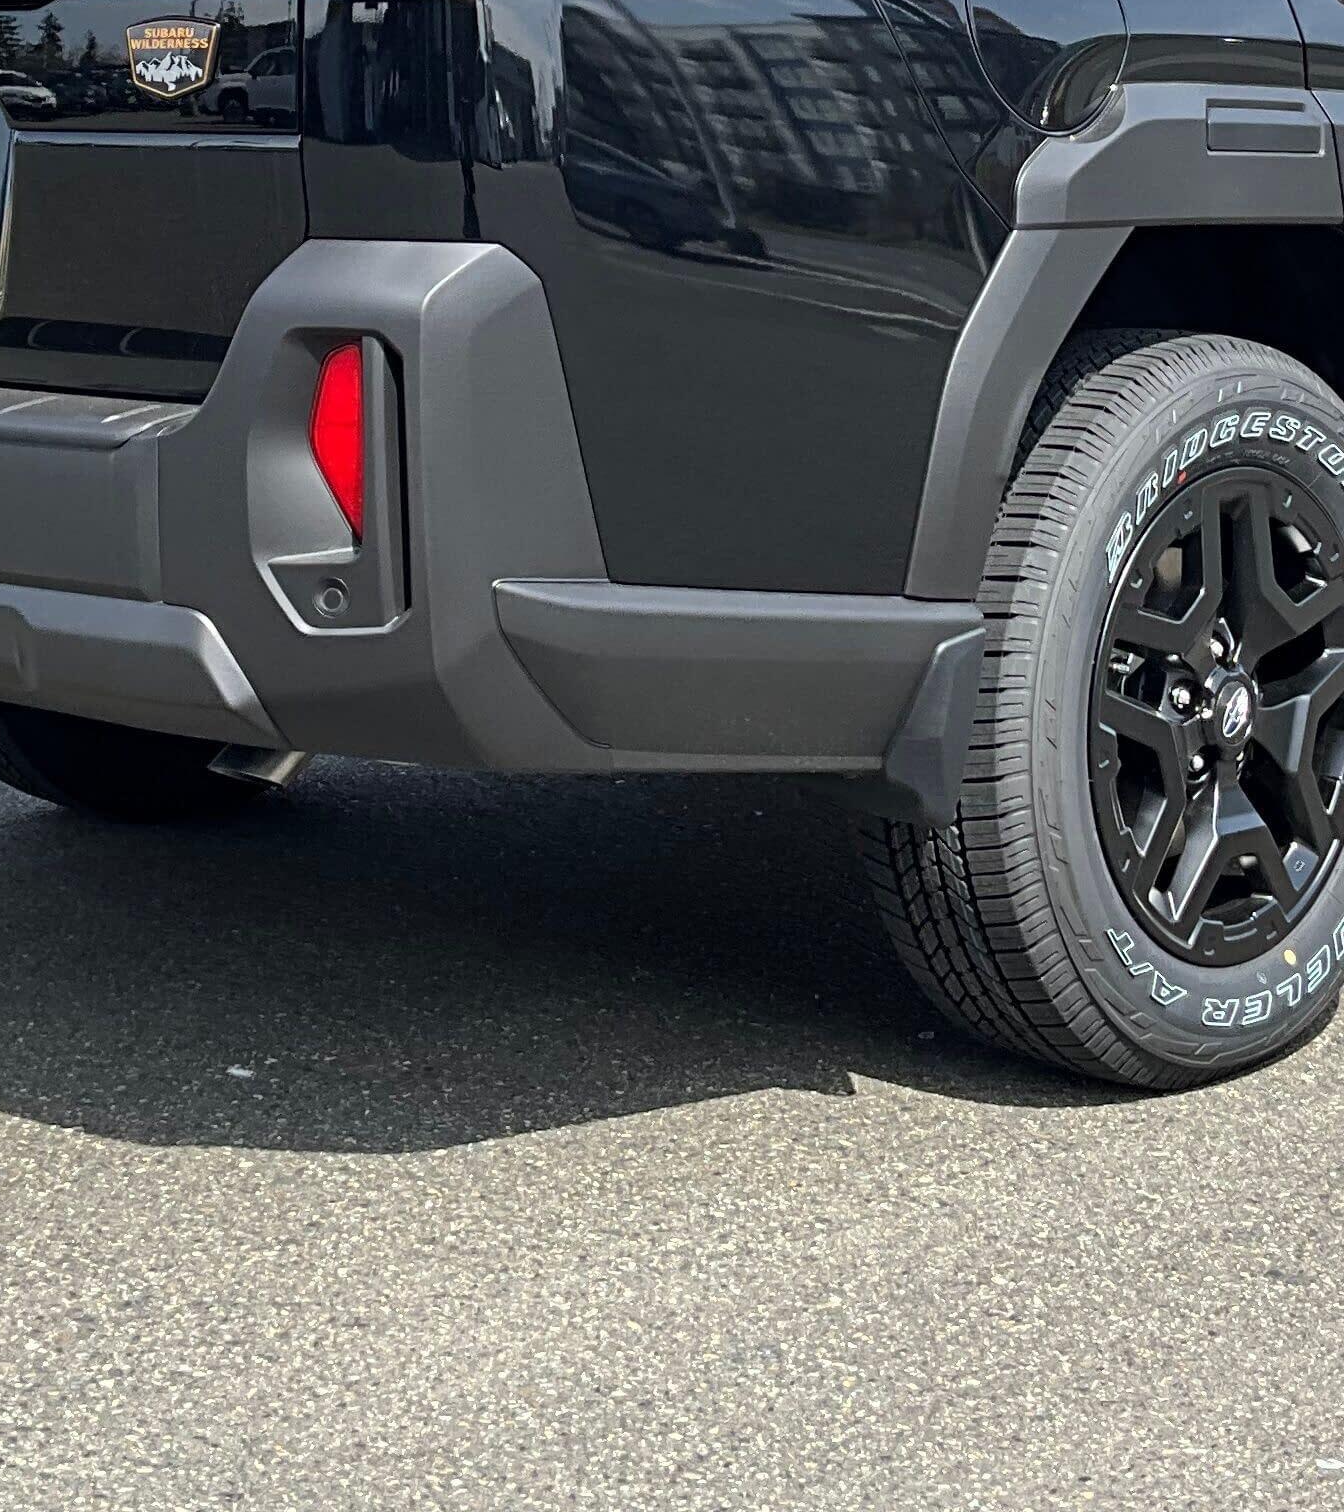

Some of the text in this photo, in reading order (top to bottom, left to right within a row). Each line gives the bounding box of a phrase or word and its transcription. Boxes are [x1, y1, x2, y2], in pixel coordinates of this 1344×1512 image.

[144, 27, 195, 39] SUBARU
[130, 37, 210, 50] WILDERNESS
[1107, 928, 1188, 1006] A/T
